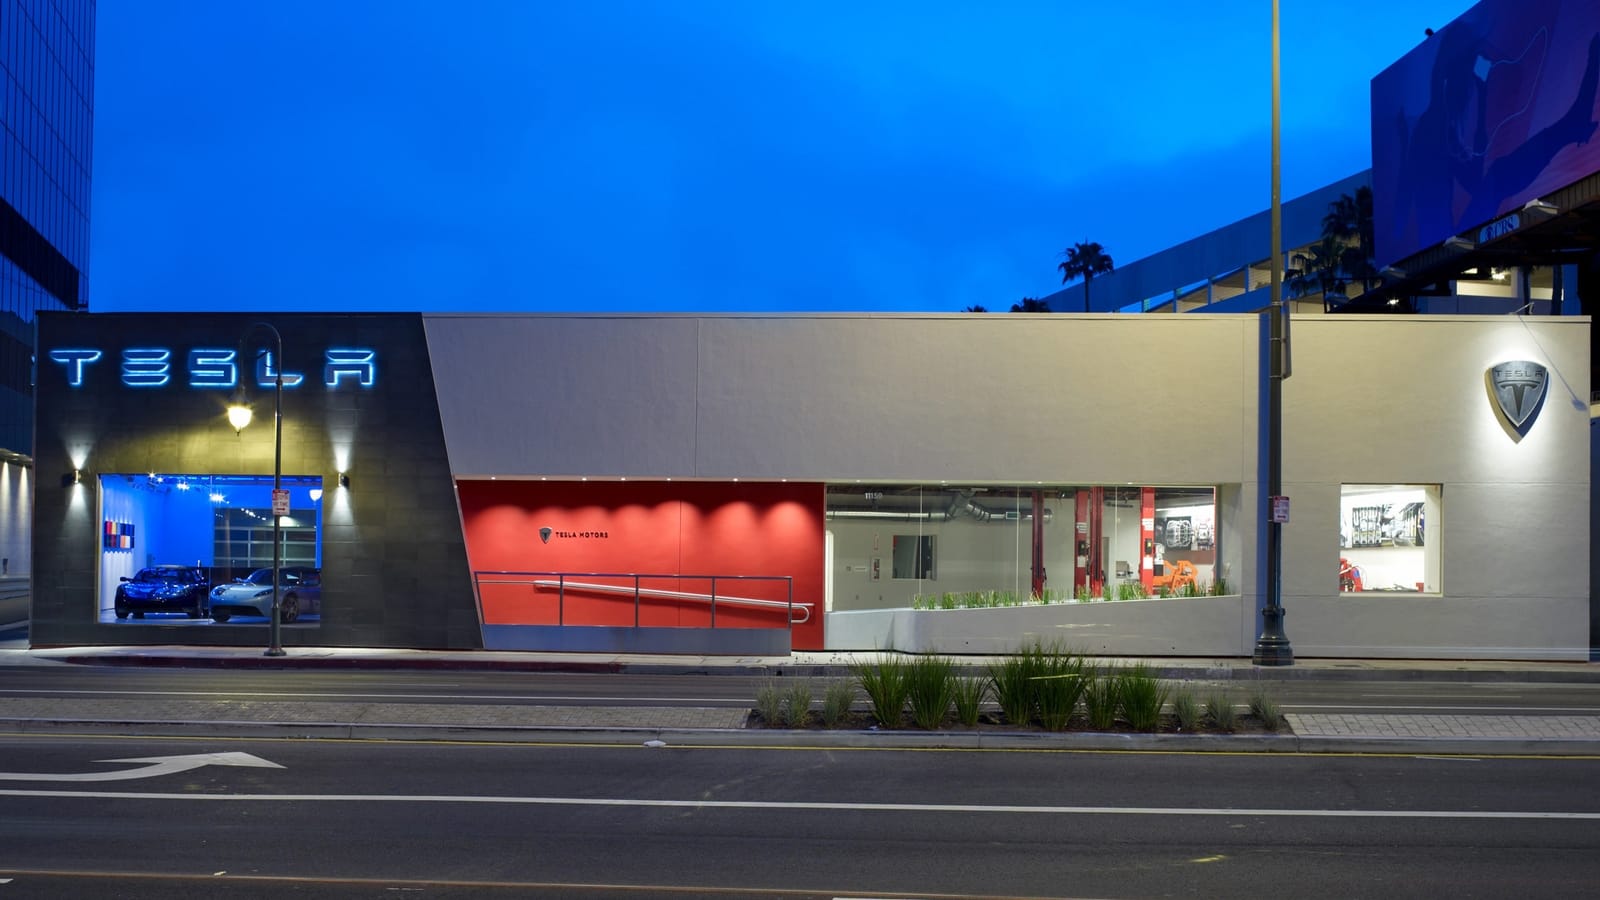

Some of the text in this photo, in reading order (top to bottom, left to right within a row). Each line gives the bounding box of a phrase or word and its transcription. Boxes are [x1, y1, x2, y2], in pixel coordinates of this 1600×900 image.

[50, 349, 375, 386] TESLA
[1495, 370, 1543, 378] TESLA
[555, 531, 609, 539] TESLA MOTORS
